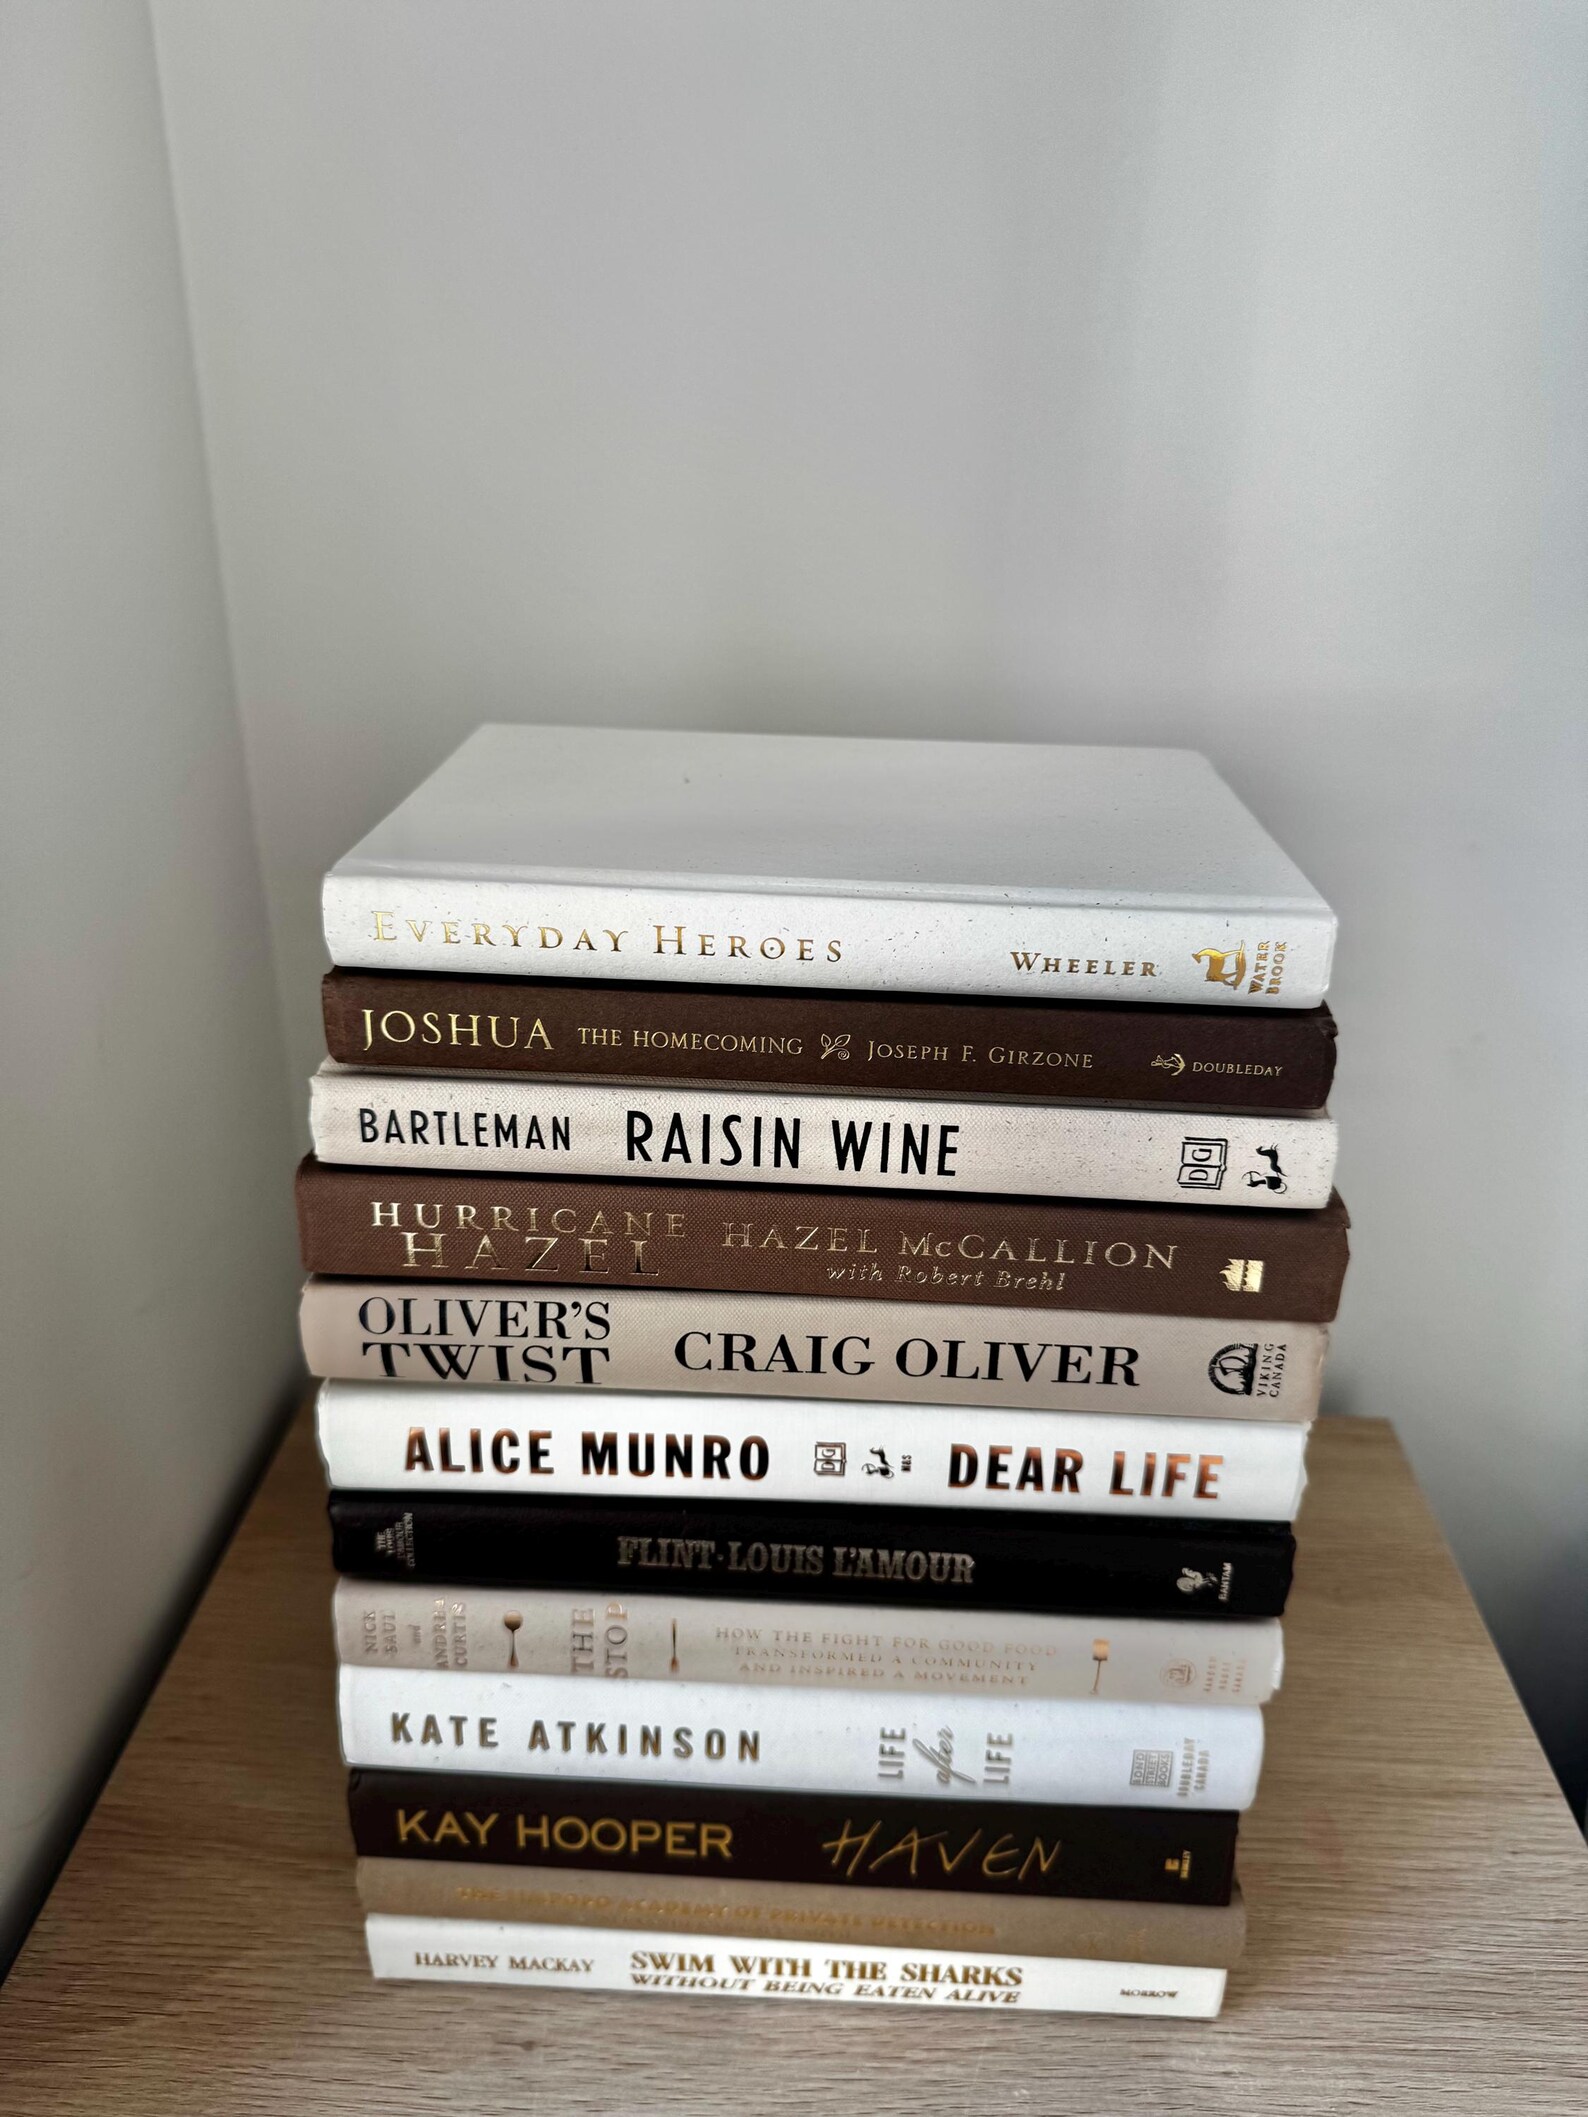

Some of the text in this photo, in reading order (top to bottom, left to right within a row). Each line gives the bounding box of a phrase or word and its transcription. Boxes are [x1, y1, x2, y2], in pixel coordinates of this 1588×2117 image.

[372, 910, 843, 962] EVERYDAY HEROES
[1010, 951, 1158, 977] WHEELER
[1248, 941, 1270, 994] WATER
[1265, 942, 1287, 994] BROOK
[362, 1009, 803, 1056] JOSHUA THE HOMECOMING
[867, 1040, 1093, 1069] JOSEPH F. GIRZONE
[1192, 1061, 1282, 1078] DOUBLEDAY
[359, 1108, 570, 1151] BARTLEMAN
[626, 1110, 959, 1176] RAISIN WINE
[372, 1202, 686, 1238] HURRICANE
[400, 1233, 659, 1276] HAZEL
[721, 1222, 1178, 1270] HAZEL McCALLION
[827, 1263, 1066, 1290] with Robert Brehl
[362, 1342, 610, 1385] TWIST
[675, 1331, 1140, 1387] CRAIG OLIVER
[1257, 1343, 1274, 1396] VIKING
[1269, 1344, 1287, 1397] CANADA
[404, 1426, 771, 1480] ALICE MUNRO
[947, 1442, 1225, 1500] DEAR LIFE
[832, 1546, 975, 1583] L'AMOUR
[1218, 1562, 1232, 1601] BANTAM
[363, 1610, 378, 1653] NICK
[383, 1611, 398, 1656] SAUL
[452, 1603, 468, 1666] CURTIS
[571, 1609, 594, 1673] THE
[605, 1602, 629, 1679] STOP
[716, 1627, 1057, 1656] HOW THE FIGHT FOR GOOD FOOD
[735, 1646, 1038, 1671] TRANSFORMED A COMMUNITY
[739, 1663, 1029, 1685] AND INSPIRED A MOVEMENT
[391, 1711, 760, 1762] KATE ATKINSON
[878, 1727, 906, 1779] LIFE
[912, 1725, 977, 1784] after
[983, 1732, 1013, 1784] LIFE
[396, 1808, 733, 1859] KAY HOOPER
[822, 1818, 1061, 1881] HAVEN
[415, 1952, 594, 1973] HARVEY MACKAY
[631, 1951, 1023, 1987] SWIM WITH THE SHARKS
[631, 1973, 1021, 2004] WITHOUT BEING EATEN ALIVE
